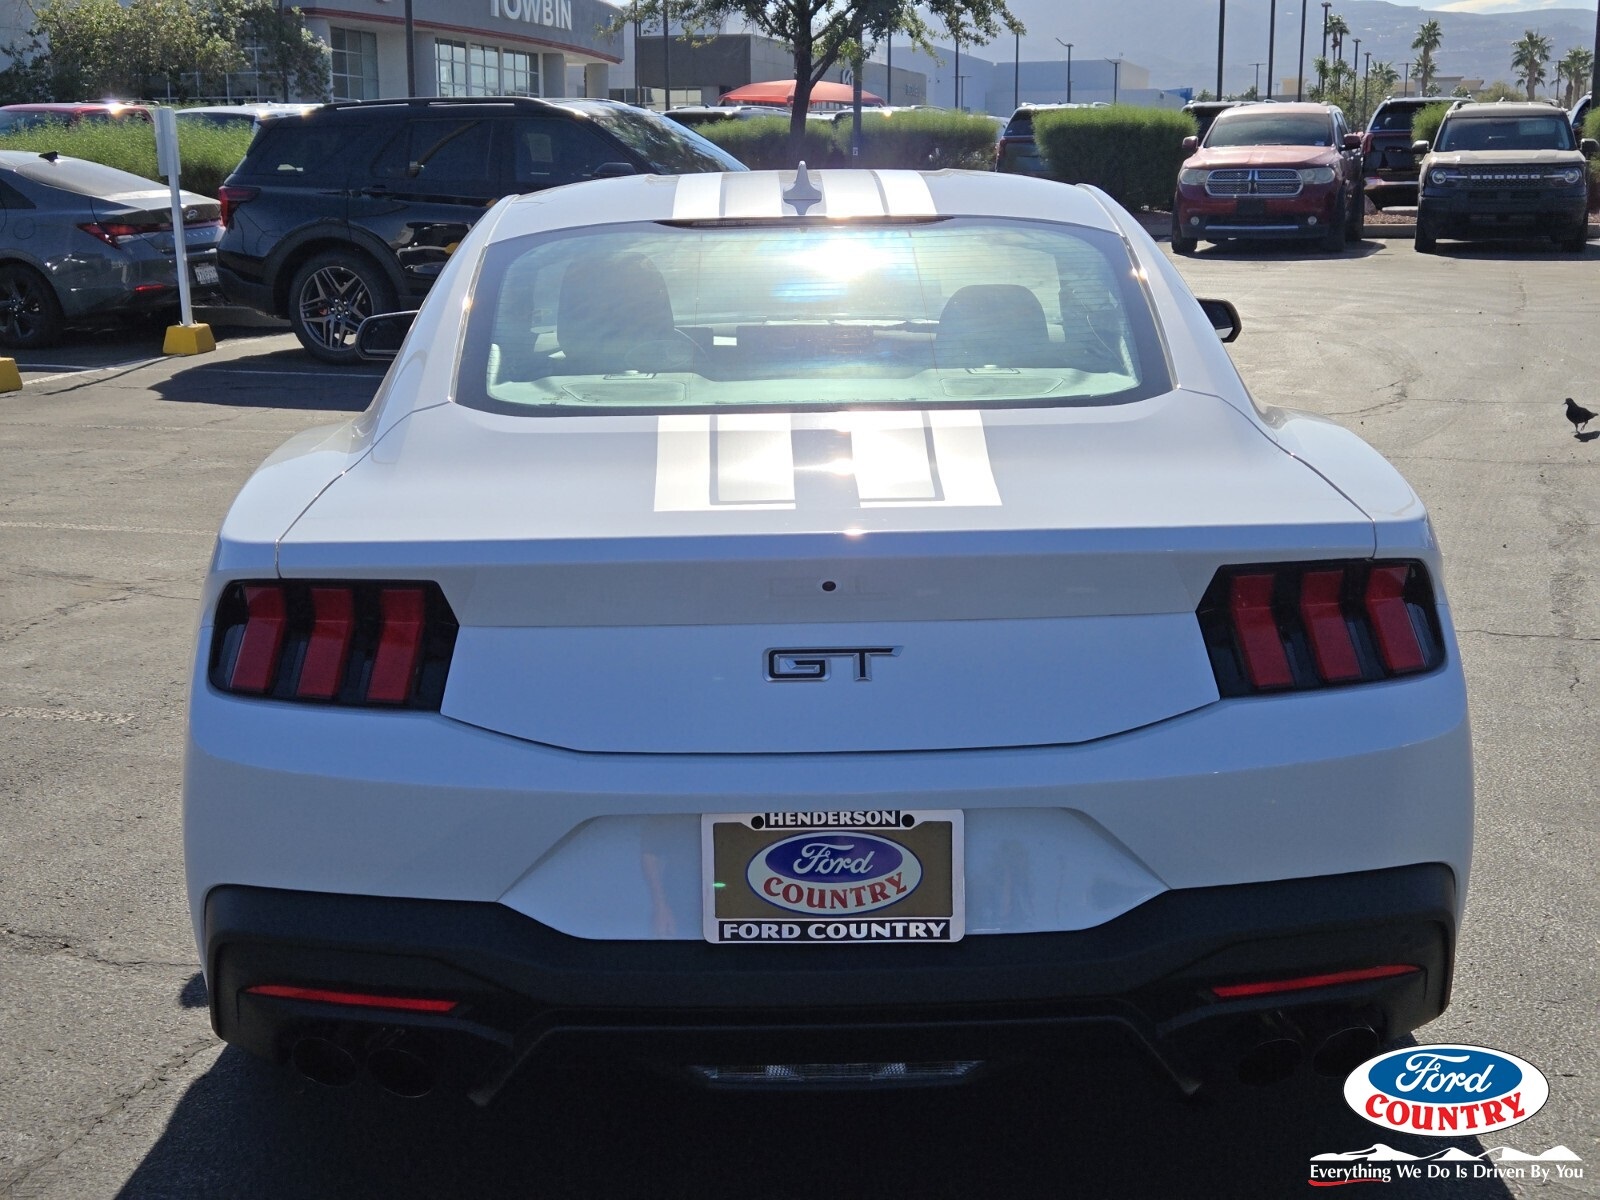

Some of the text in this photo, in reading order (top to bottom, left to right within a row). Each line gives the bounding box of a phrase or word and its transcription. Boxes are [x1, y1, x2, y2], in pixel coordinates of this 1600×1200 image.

[762, 645, 904, 682] GT
[769, 810, 896, 827] HENDERSON
[793, 843, 875, 875] Ford
[763, 872, 908, 910] COUNTRY
[723, 922, 947, 940] FORD COUNTRY
